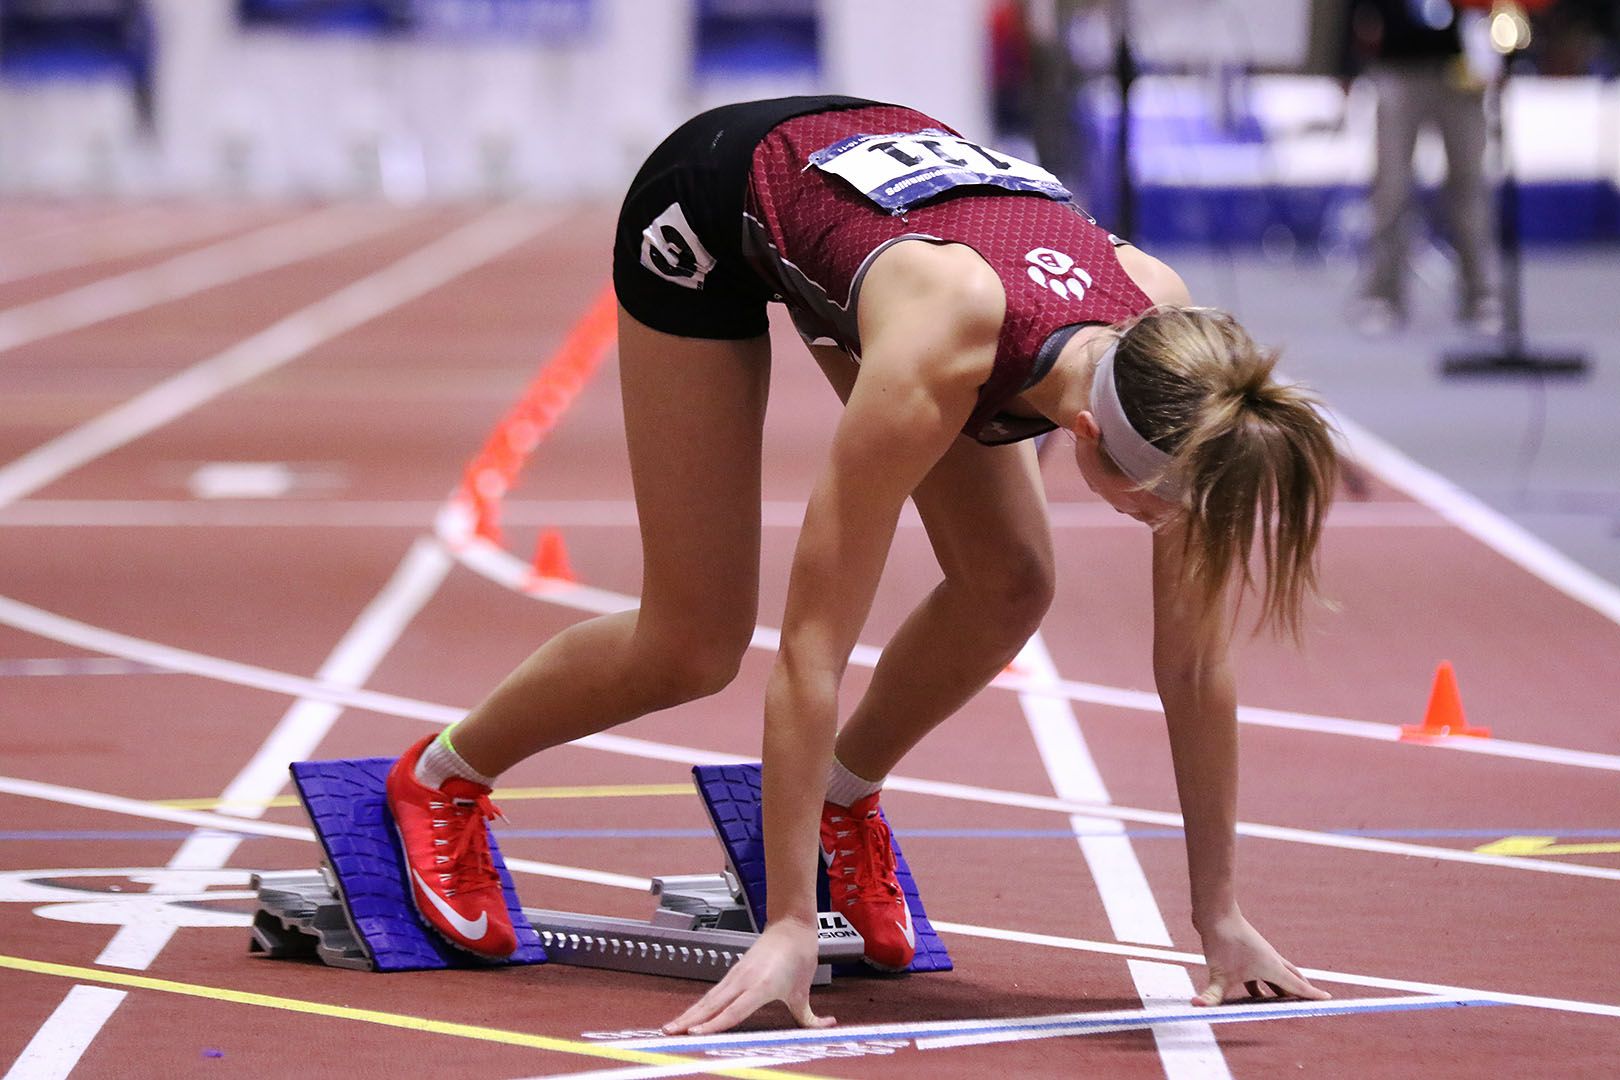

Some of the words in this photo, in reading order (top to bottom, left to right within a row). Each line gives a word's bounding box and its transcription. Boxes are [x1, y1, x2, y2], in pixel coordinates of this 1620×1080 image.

[867, 139, 1012, 171] 111
[884, 167, 958, 196] PIONSHIPS
[817, 916, 848, 930] LL
[817, 930, 857, 939] SION
